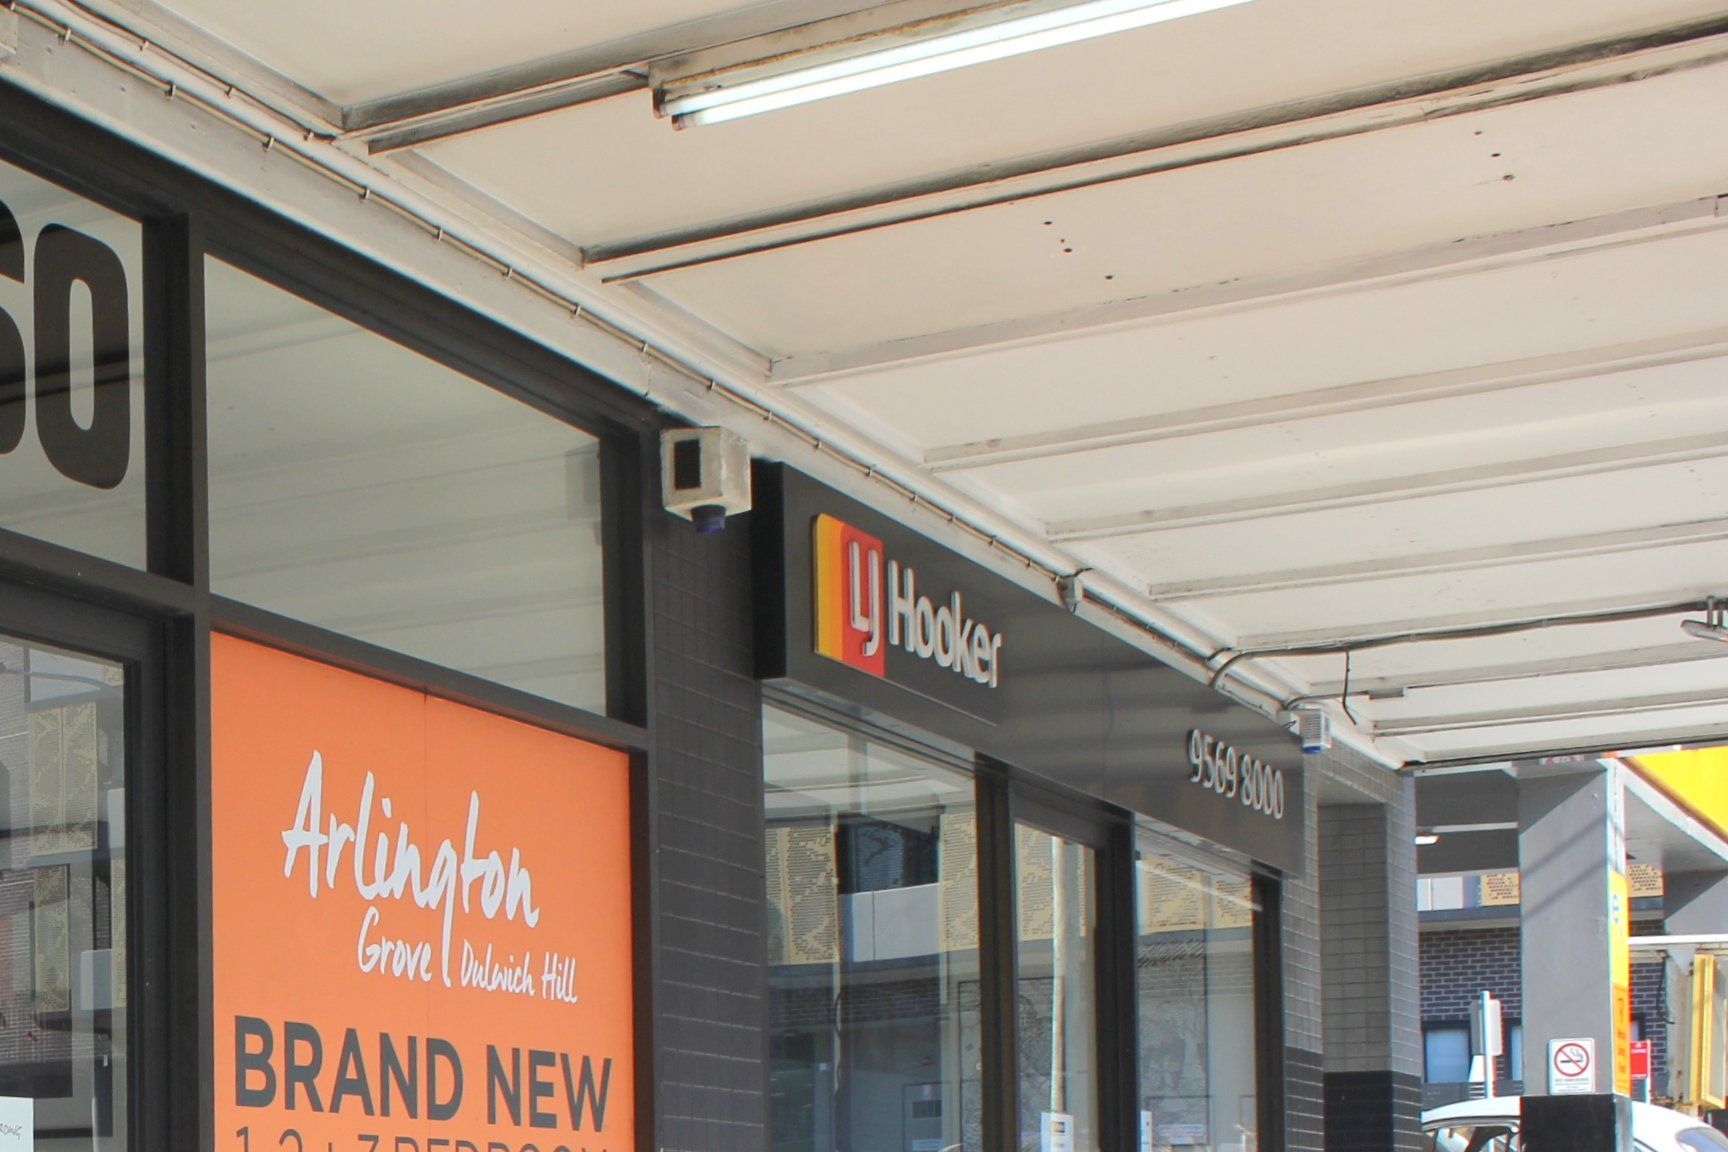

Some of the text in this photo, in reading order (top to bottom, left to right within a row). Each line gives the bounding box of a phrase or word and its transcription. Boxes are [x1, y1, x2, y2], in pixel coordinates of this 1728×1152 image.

[848, 540, 1002, 689] LJ Hooker
[1189, 728, 1284, 820] 9569 8000
[282, 749, 540, 987] Arlington
[358, 906, 578, 1003] Grove Dulwich Hill
[235, 1015, 612, 1132] BRAND NEW
